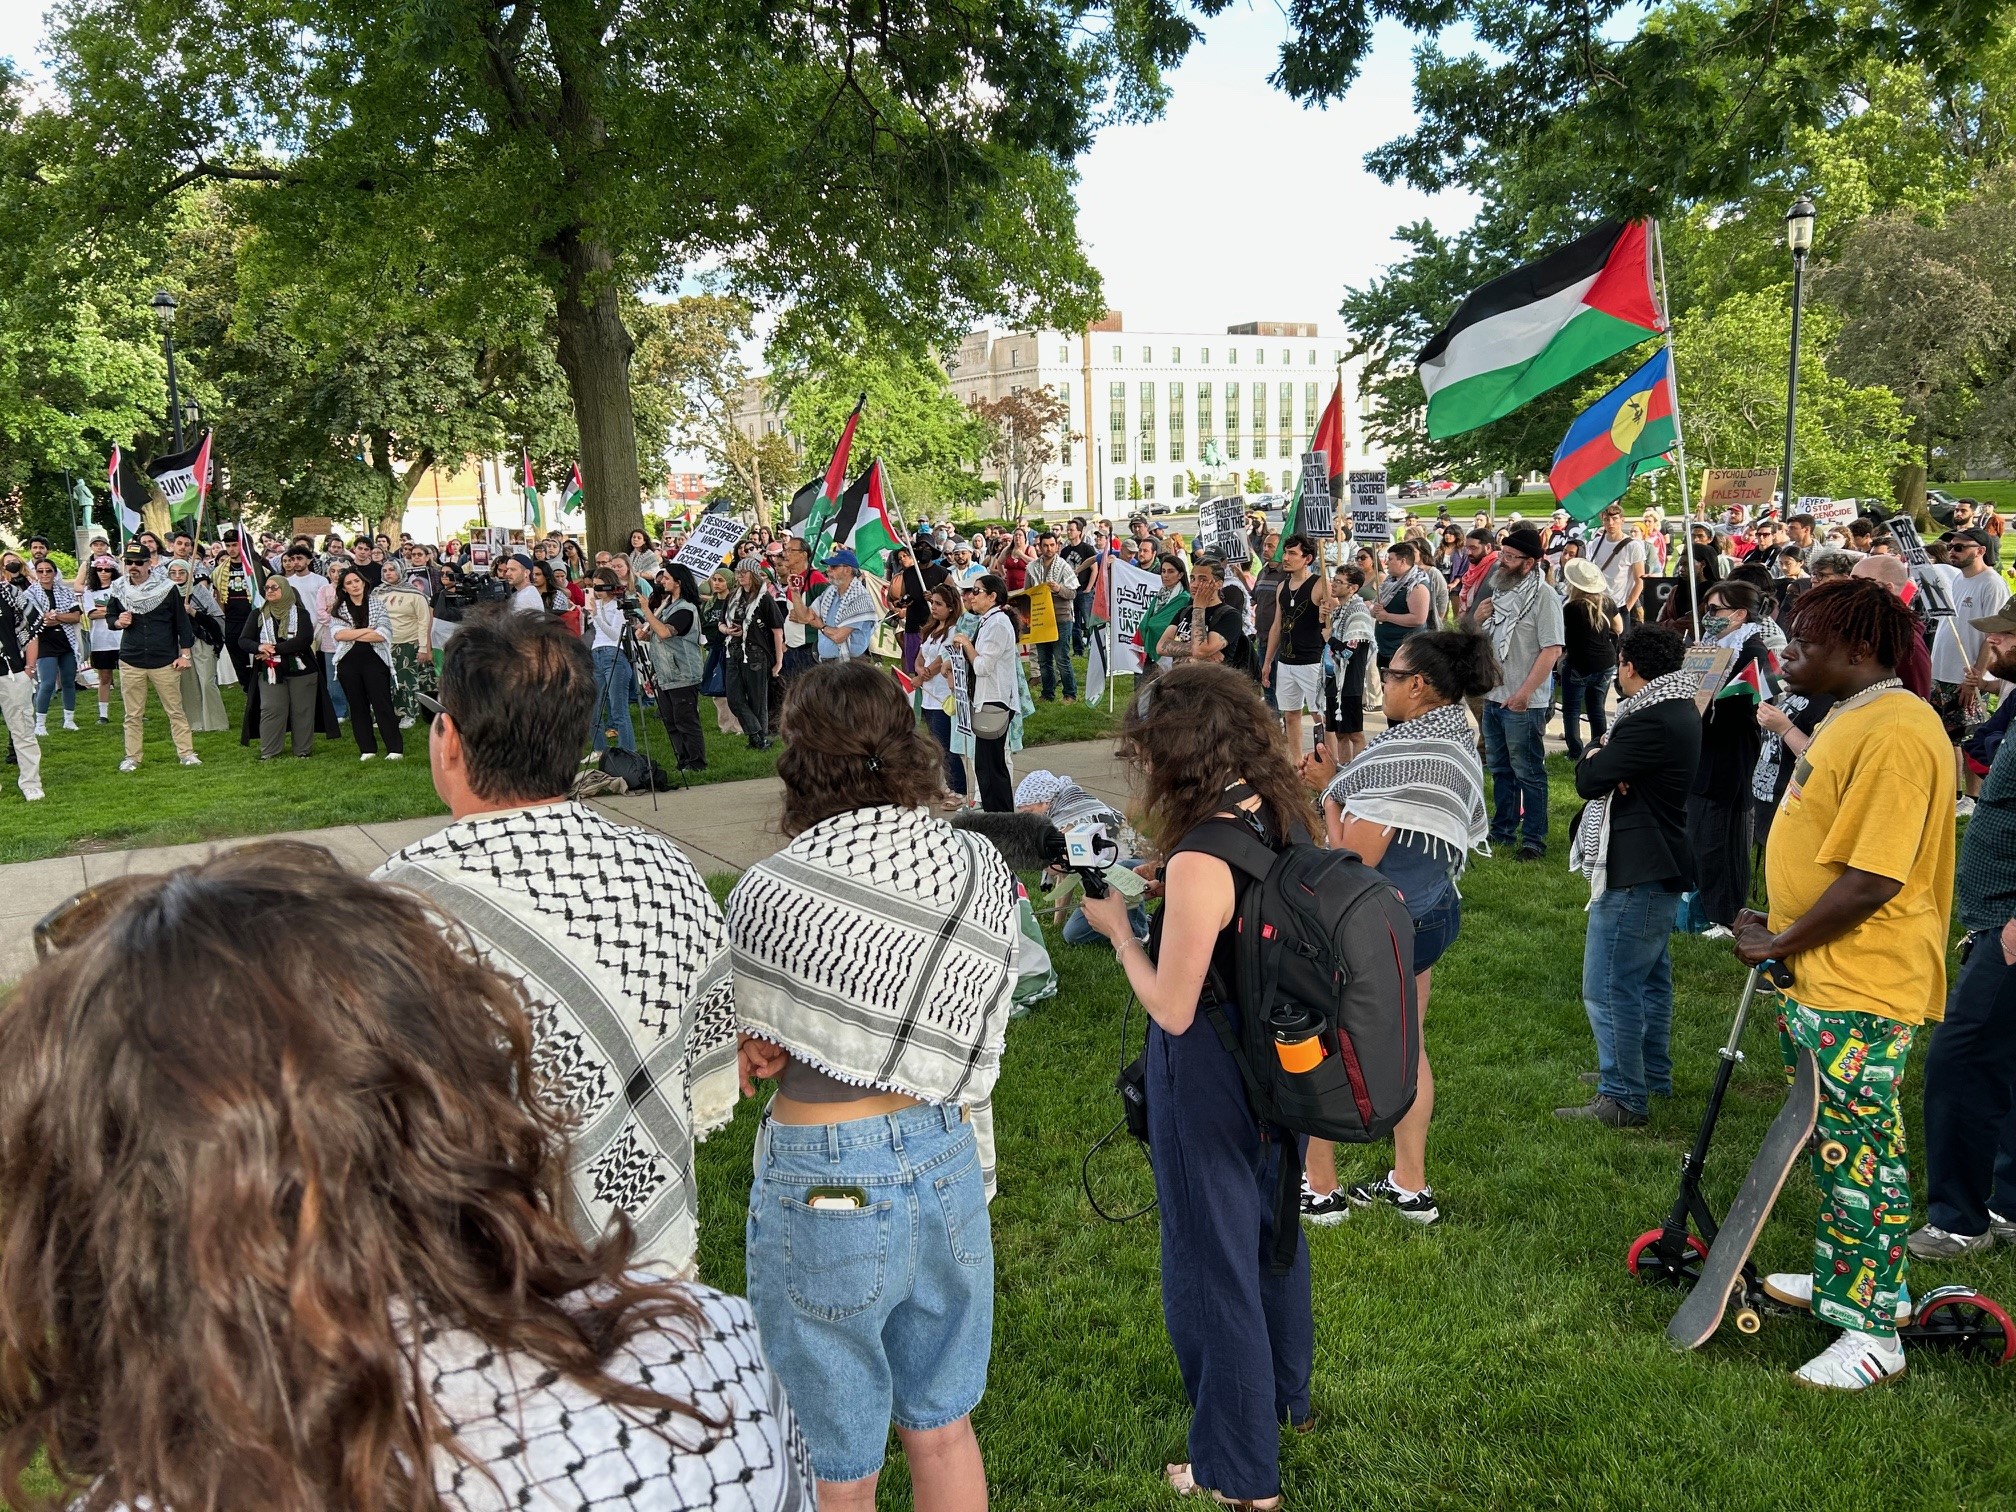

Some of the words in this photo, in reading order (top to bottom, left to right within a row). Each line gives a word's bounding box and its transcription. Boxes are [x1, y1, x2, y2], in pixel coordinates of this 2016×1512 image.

[1349, 472, 1386, 483] RESISTANCE
[1709, 468, 1777, 480] PSYCHOLOGISTS
[1315, 477, 1329, 494] THE
[1350, 484, 1356, 494] IS
[1356, 483, 1385, 494] JUSTIFIED
[1733, 480, 1747, 488] FOR
[1712, 488, 1762, 500] PALESTINE
[1214, 499, 1230, 510] STAND
[1230, 496, 1243, 506] WITH
[1359, 495, 1378, 506] WHEN
[1813, 504, 1833, 512] STOP
[1814, 508, 1852, 520] GENOCIDE
[1306, 507, 1332, 530] NOW!
[1352, 511, 1375, 522] PEOPLE
[1375, 511, 1388, 522] ARE
[704, 515, 746, 536] RESISTANCE
[1217, 518, 1231, 532] END
[1231, 515, 1245, 529] THE
[1355, 523, 1387, 534] OCCUPIED!
[699, 524, 708, 533] IS
[706, 528, 739, 543] JUSTIFIED
[701, 535, 723, 548] WHEN
[682, 544, 709, 560] PEOPLE
[706, 552, 723, 564] ARE
[677, 554, 714, 572] OCCUPIED!
